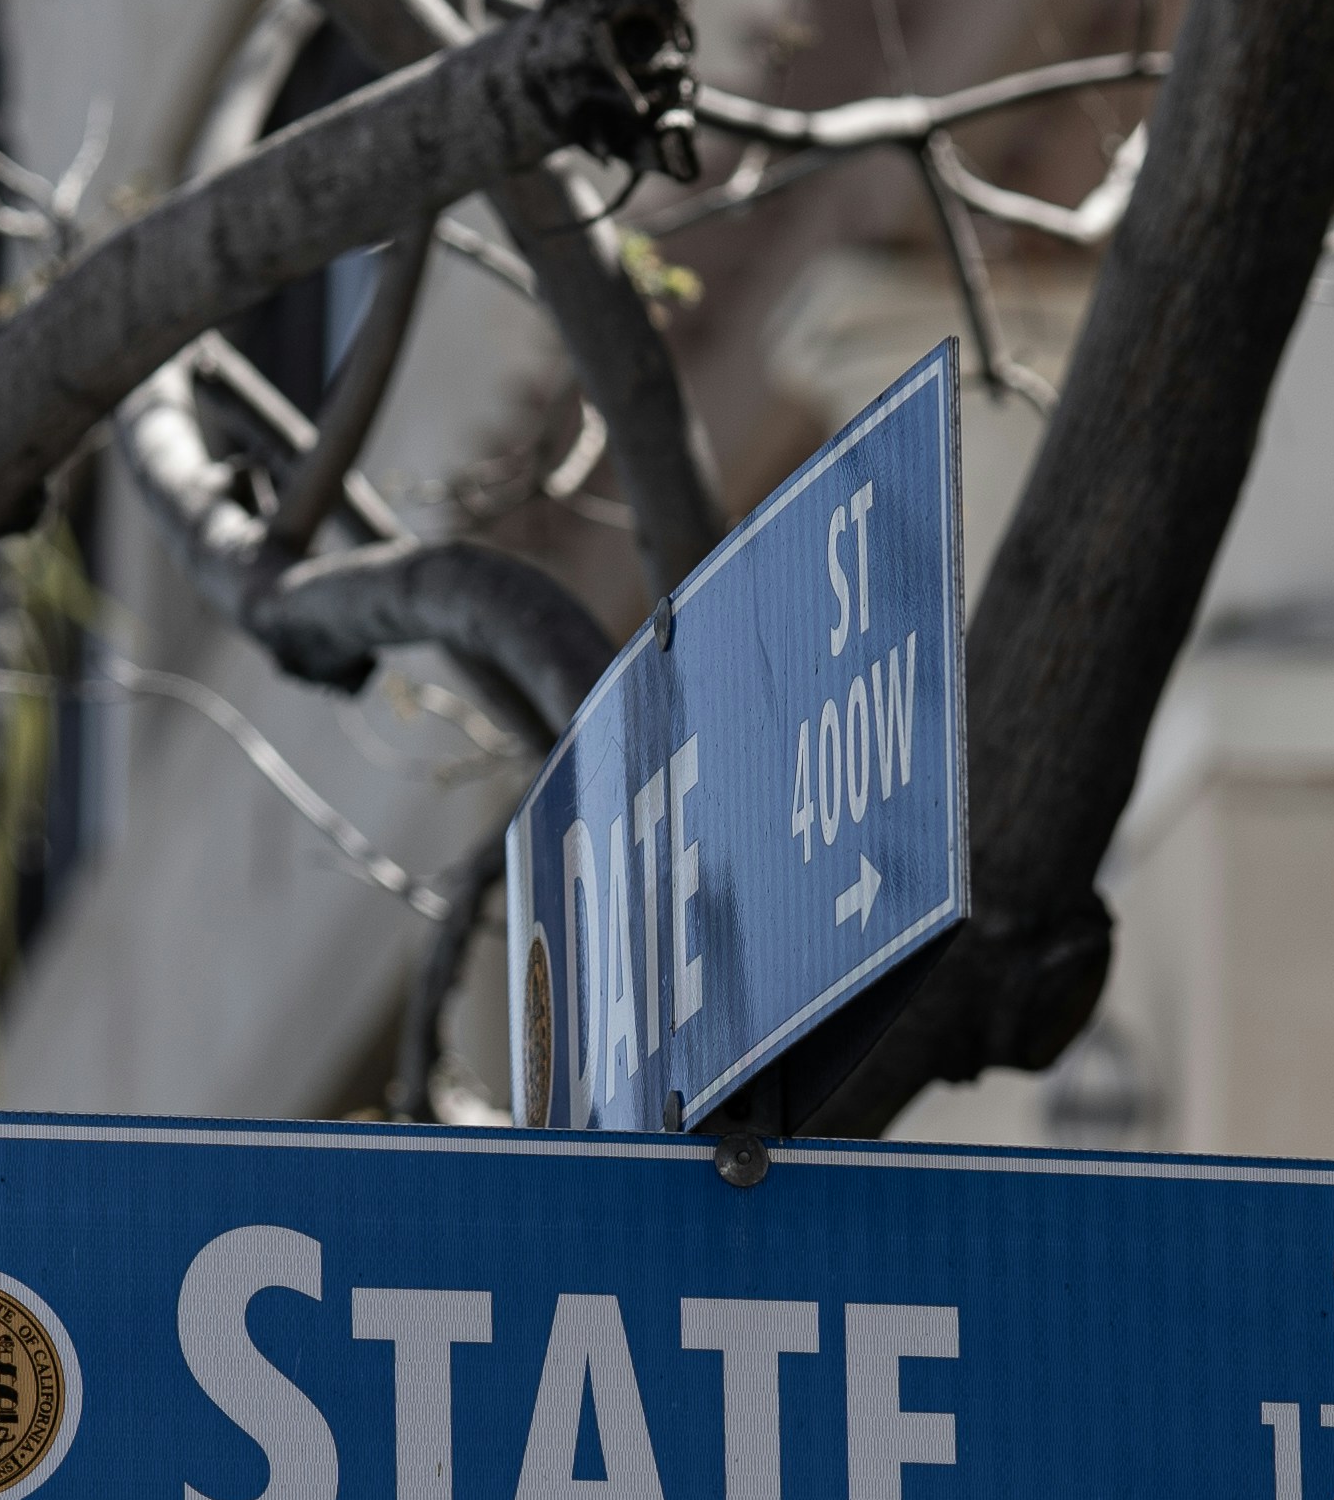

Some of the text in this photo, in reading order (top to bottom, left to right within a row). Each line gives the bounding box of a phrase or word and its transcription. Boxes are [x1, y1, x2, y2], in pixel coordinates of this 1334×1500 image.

[829, 482, 874, 657] ST
[791, 632, 916, 863] 400W
[563, 735, 703, 1129] DATE
[18, 1325, 38, 1346] OF
[21, 1350, 54, 1453] CALIFORNIA
